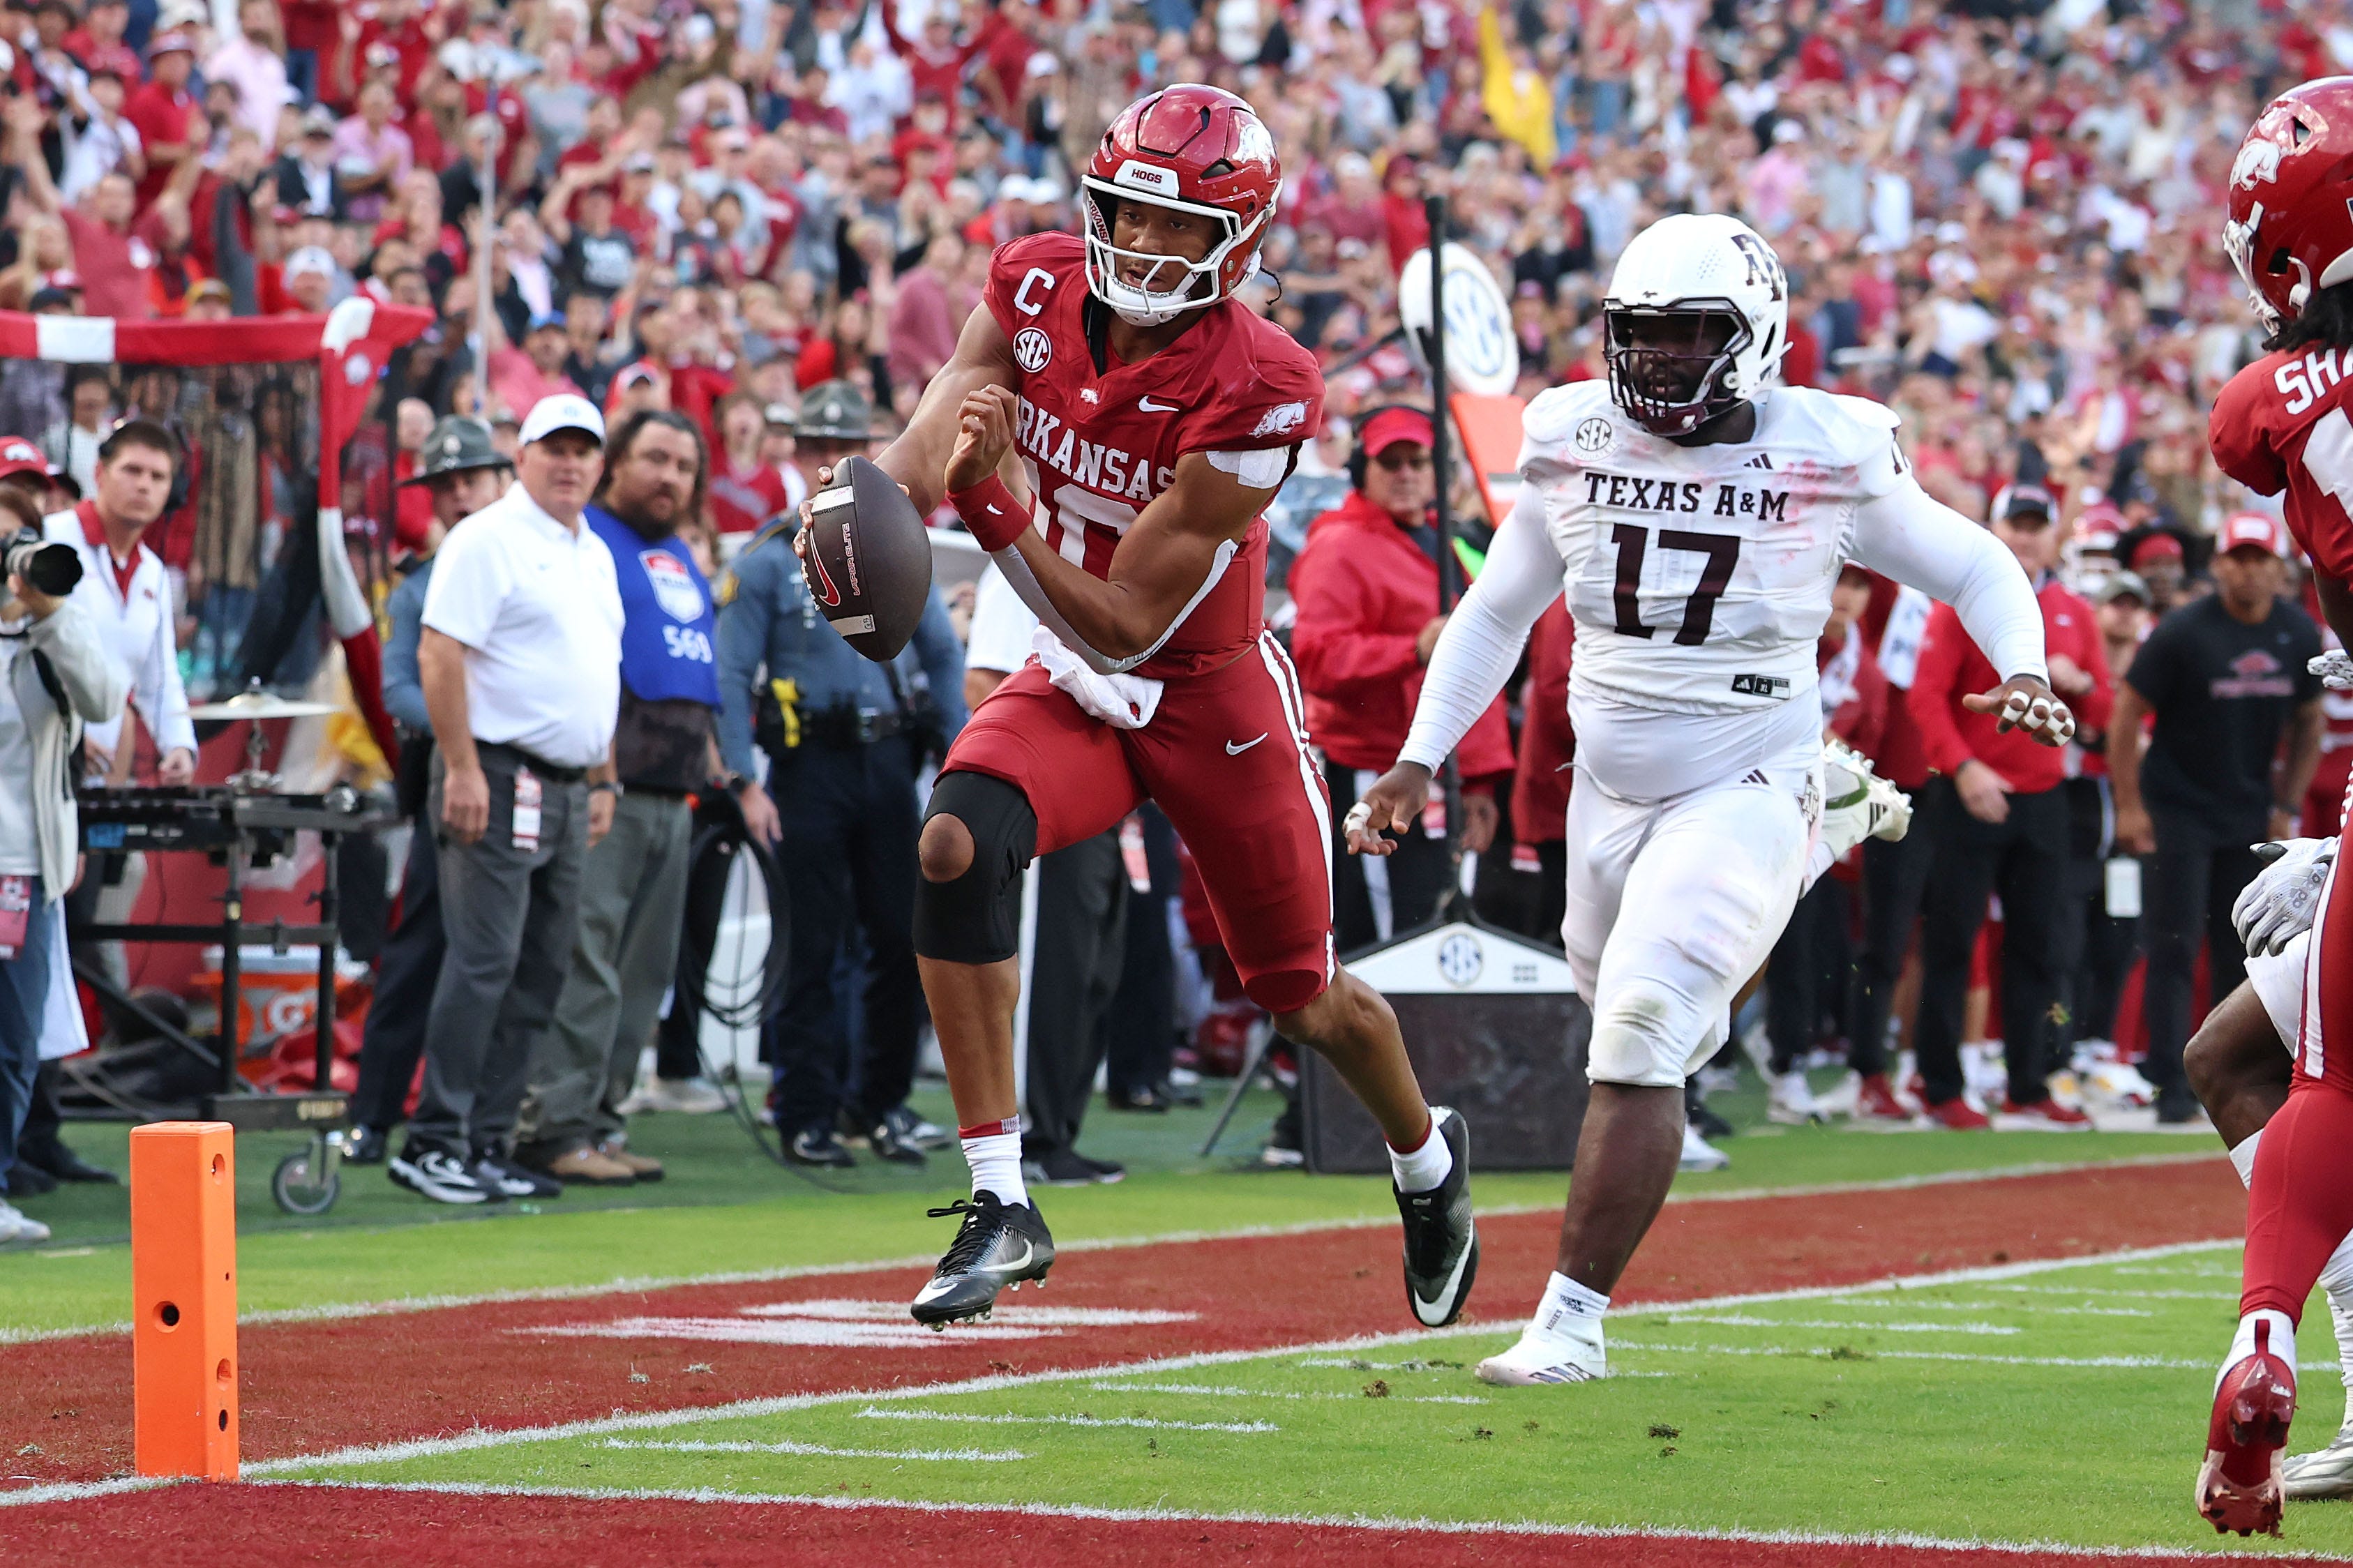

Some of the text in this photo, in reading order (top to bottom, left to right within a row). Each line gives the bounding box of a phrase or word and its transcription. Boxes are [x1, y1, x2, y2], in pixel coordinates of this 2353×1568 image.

[1131, 168, 1162, 184] HOGS
[1014, 267, 1055, 317] C
[1016, 329, 1048, 371] SEC
[1016, 394, 1177, 502] RKANSAS
[1577, 419, 1611, 451] SEC
[1584, 472, 1789, 522] TEXAS A&M
[841, 522, 860, 596] VAPOR ELITE
[1611, 522, 1741, 645] 17
